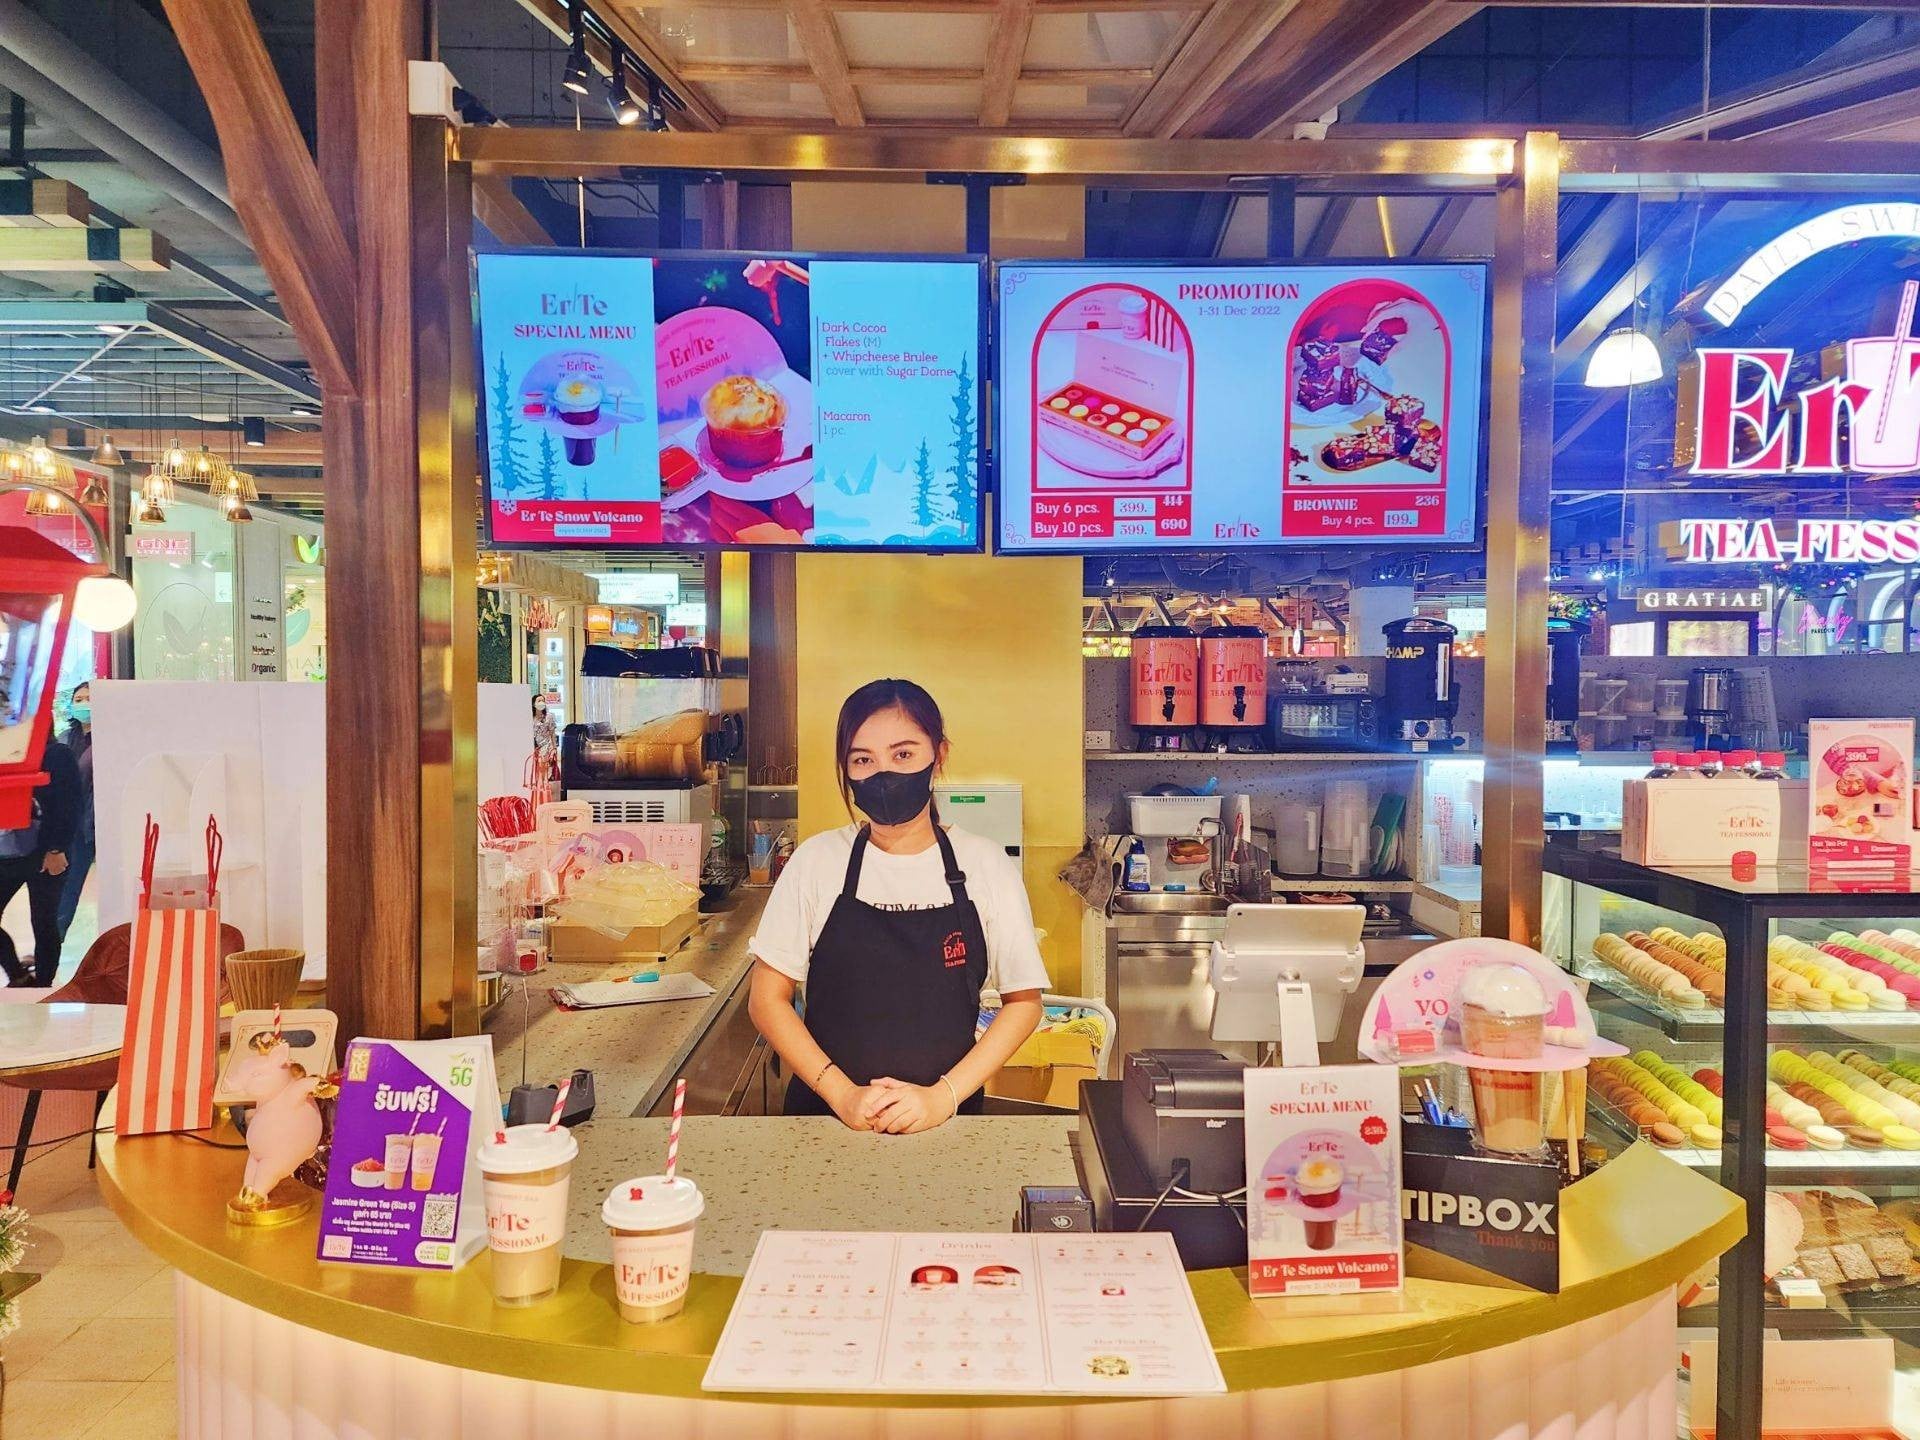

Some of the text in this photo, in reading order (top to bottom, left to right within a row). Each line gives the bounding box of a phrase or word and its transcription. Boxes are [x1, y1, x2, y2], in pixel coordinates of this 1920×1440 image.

[1712, 222, 1821, 319] DAILY
[1179, 283, 1300, 300] PROMOTION
[1199, 305, 1280, 316] 1-31 Dec 2022
[514, 324, 636, 340] SPECIAL MENU
[822, 321, 887, 333] Dark Cocoa
[825, 336, 882, 348] Flakes (M)
[832, 351, 900, 365] Whipcheese
[903, 352, 939, 362] Brulee
[825, 365, 953, 380] cover with Sugar Dome
[823, 411, 871, 421] Macaron
[1035, 502, 1059, 517] Buy
[1063, 502, 1071, 514] 6
[1075, 503, 1100, 517] pcs.
[1293, 499, 1358, 512] BROWNIE
[520, 510, 643, 523] Er Te Snow Volcano
[1322, 515, 1343, 528] Buy
[1344, 516, 1351, 525] 4
[1354, 516, 1375, 528] pcs.
[1034, 522, 1058, 537] Buy
[1062, 522, 1075, 533] 10
[1079, 523, 1104, 537] pcs.
[1161, 519, 1188, 530] 690
[252, 663, 276, 675] Organic
[449, 1066, 472, 1088] 5G
[373, 1083, 439, 1114] รับฟรี!
[1270, 1100, 1373, 1116] SPECIAL MENU
[332, 1197, 358, 1207] Jasmine
[1402, 1189, 1556, 1235] TIPBOX
[1475, 1230, 1525, 1249] Thank
[1263, 1261, 1389, 1278] Er Te Snow Volcano
